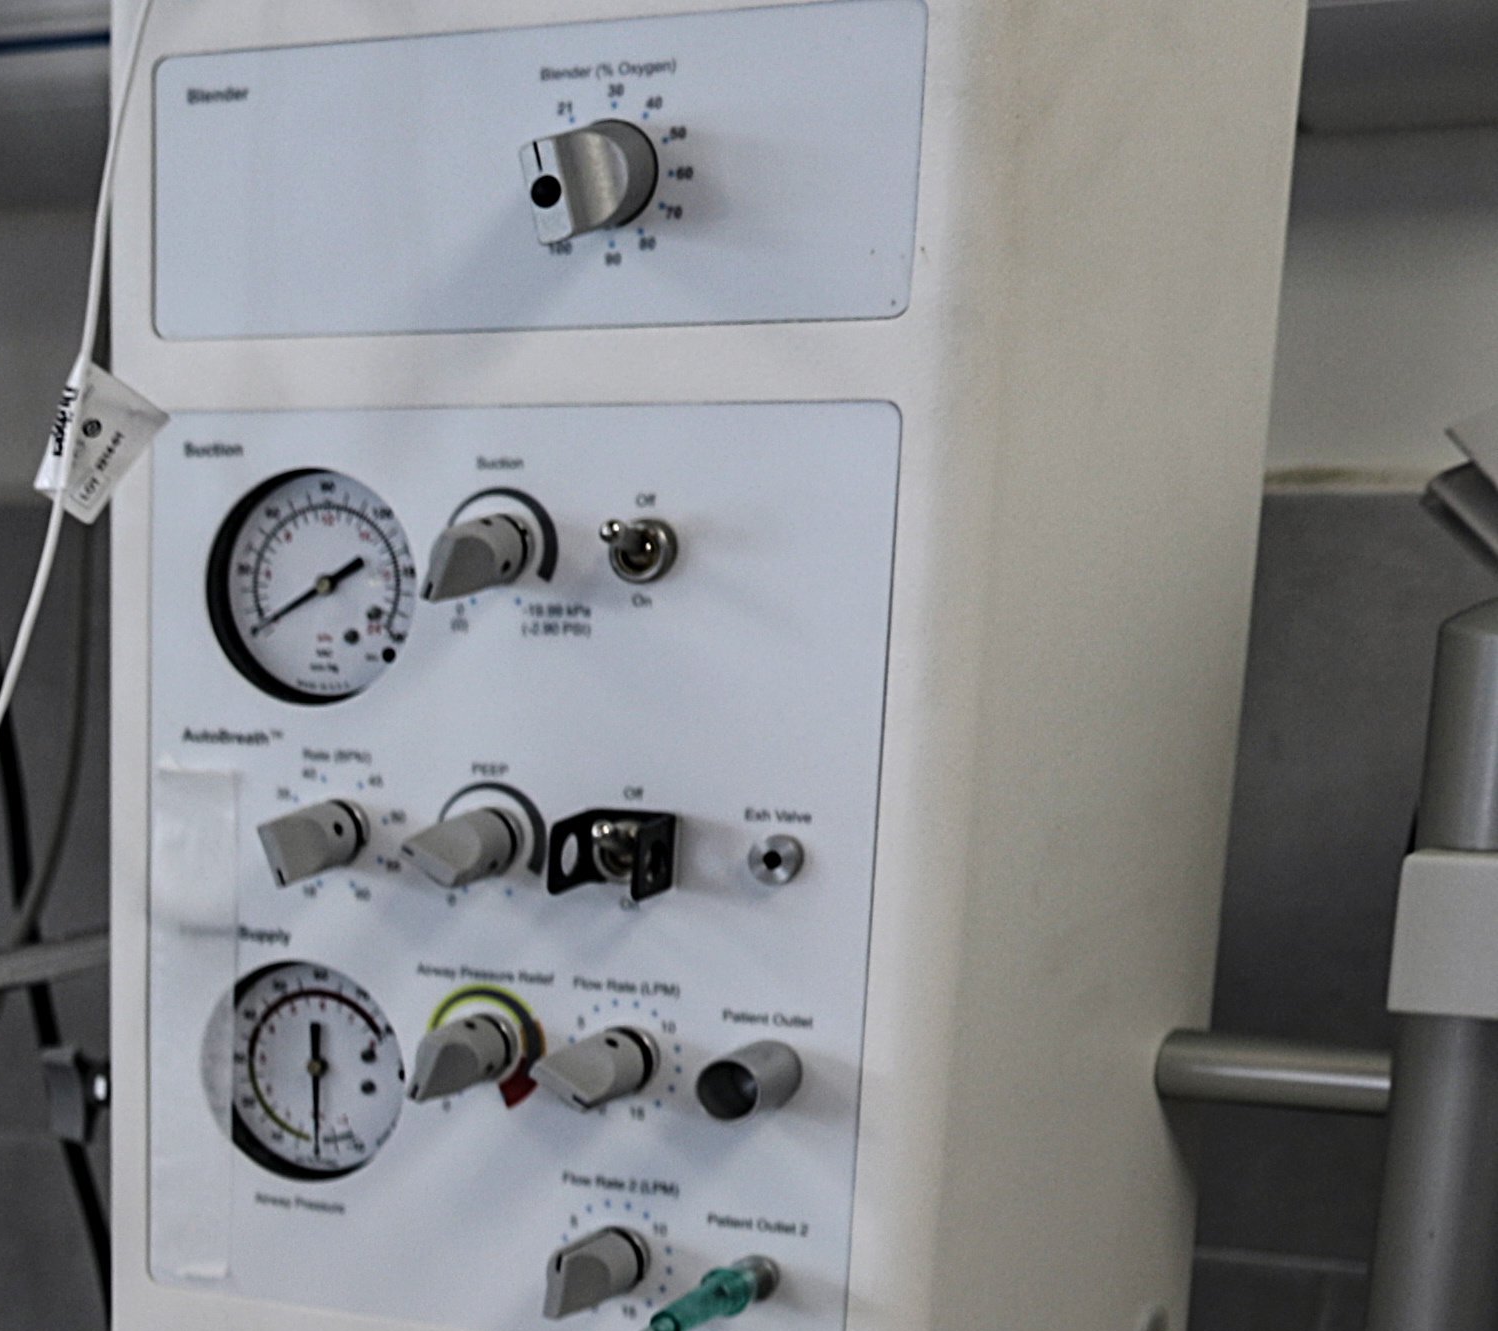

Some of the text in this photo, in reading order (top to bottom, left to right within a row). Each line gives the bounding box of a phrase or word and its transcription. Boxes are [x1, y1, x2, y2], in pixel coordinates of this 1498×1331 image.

[540, 65, 592, 81] Blender
[618, 58, 678, 79] Oxygen)
[187, 86, 250, 106] Blender
[183, 439, 245, 459] Suction
[476, 455, 525, 471] Suction
[636, 491, 657, 508] Off
[631, 592, 653, 609] On
[471, 762, 509, 777] PEEP
[744, 806, 813, 825] Exh Valve
[417, 961, 556, 986] Airway Pressure Relief
[573, 976, 681, 1000] Flow Rate (LPM)
[722, 1007, 814, 1029] Patient Outlet
[562, 1170, 681, 1200] Flow Rate 2 (LPM)
[707, 1212, 809, 1236] Patient Outlet 2
